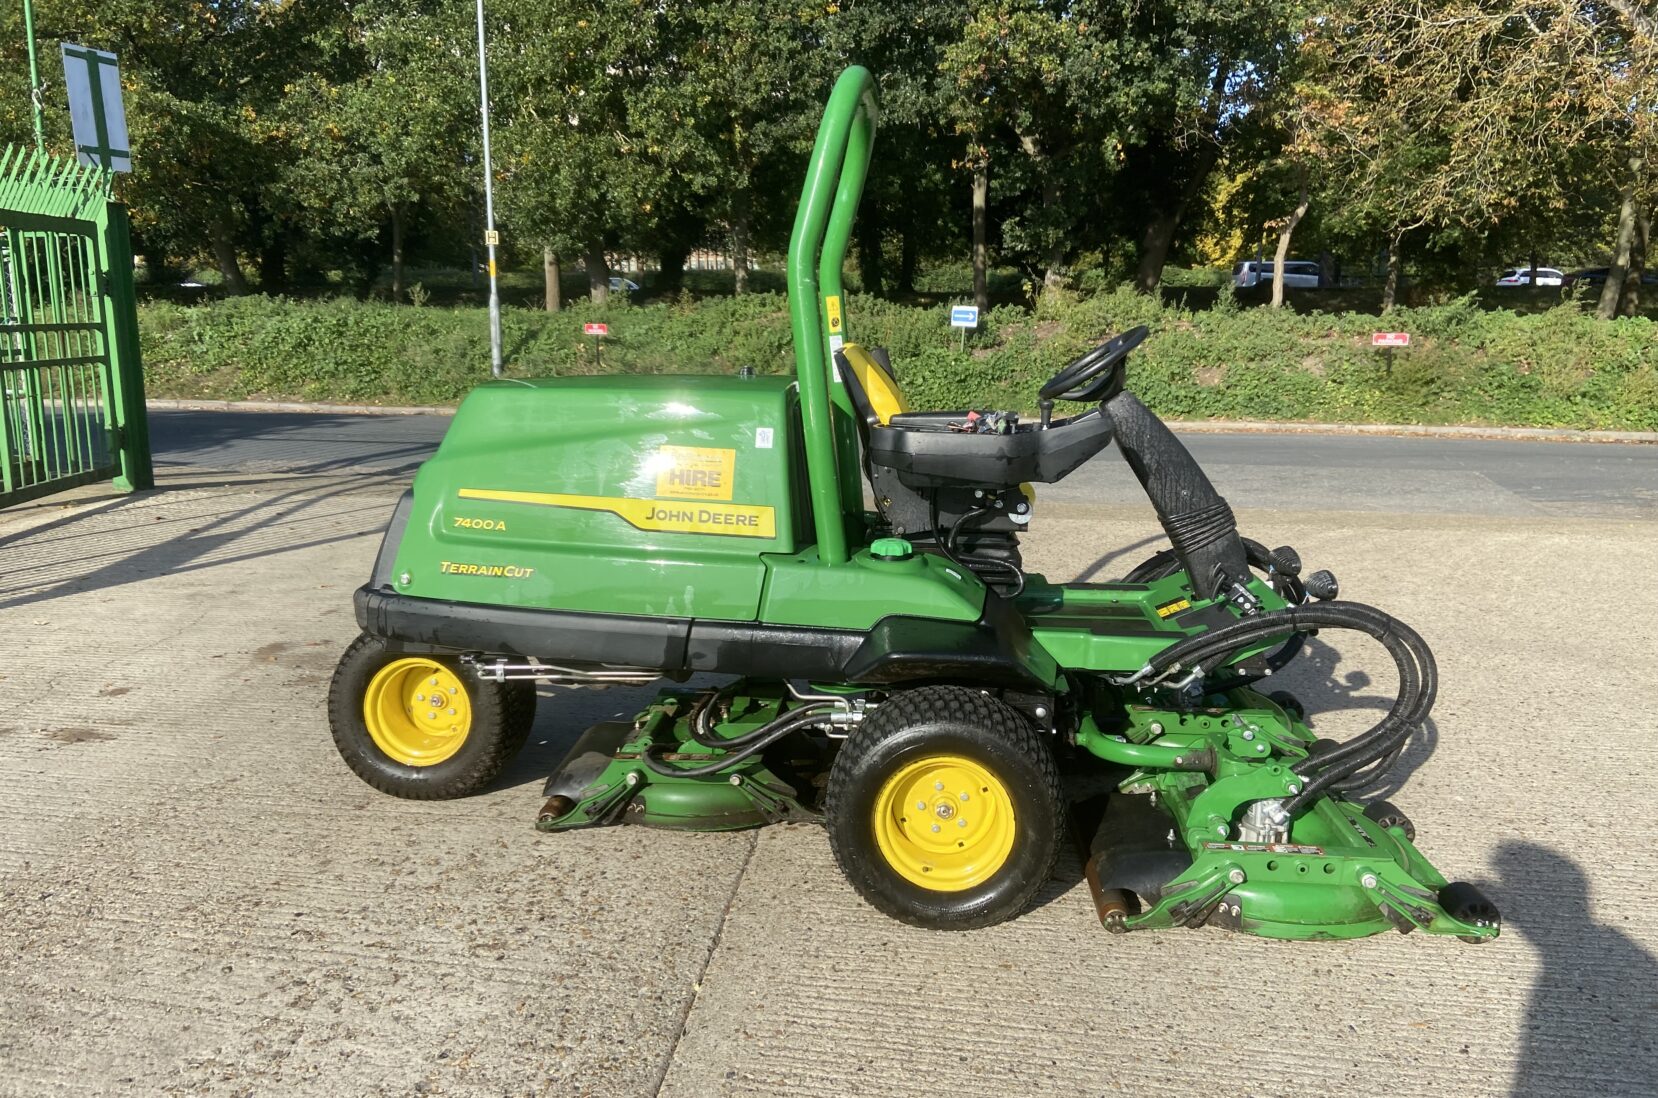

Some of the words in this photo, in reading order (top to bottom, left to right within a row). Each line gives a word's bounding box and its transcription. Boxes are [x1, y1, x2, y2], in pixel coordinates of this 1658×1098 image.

[669, 468, 721, 488] HIRE
[645, 507, 694, 523] JOHN
[698, 510, 760, 527] DEERE
